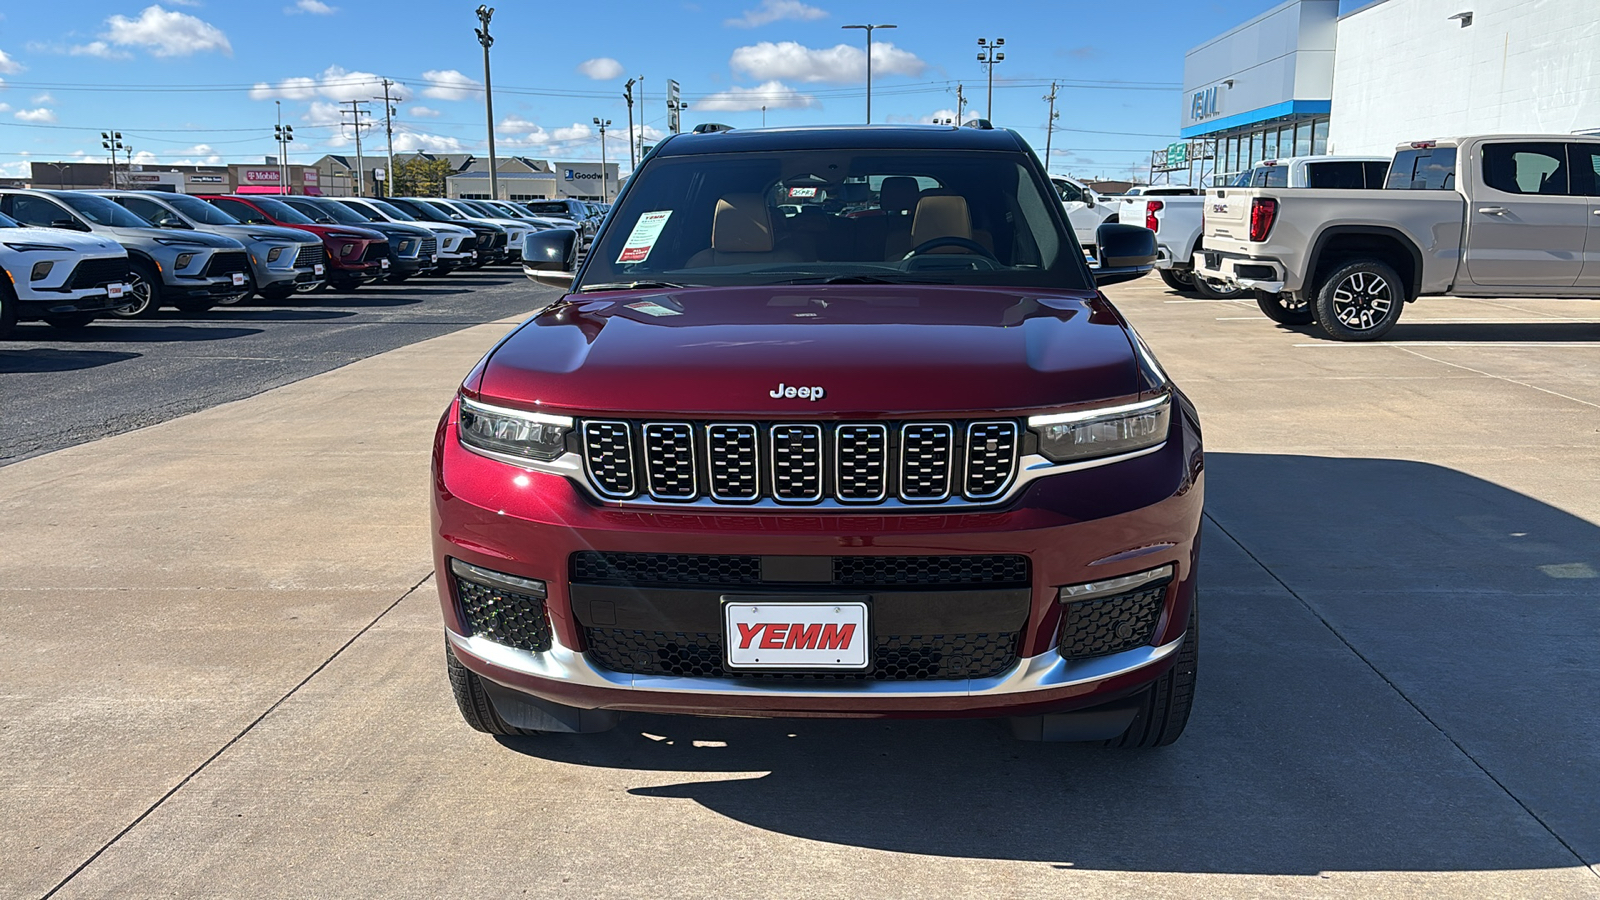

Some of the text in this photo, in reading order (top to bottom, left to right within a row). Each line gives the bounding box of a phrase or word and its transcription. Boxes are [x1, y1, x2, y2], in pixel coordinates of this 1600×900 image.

[575, 172, 609, 180] Goodwl
[769, 383, 824, 401] Jeep
[736, 623, 857, 649] YEMM
